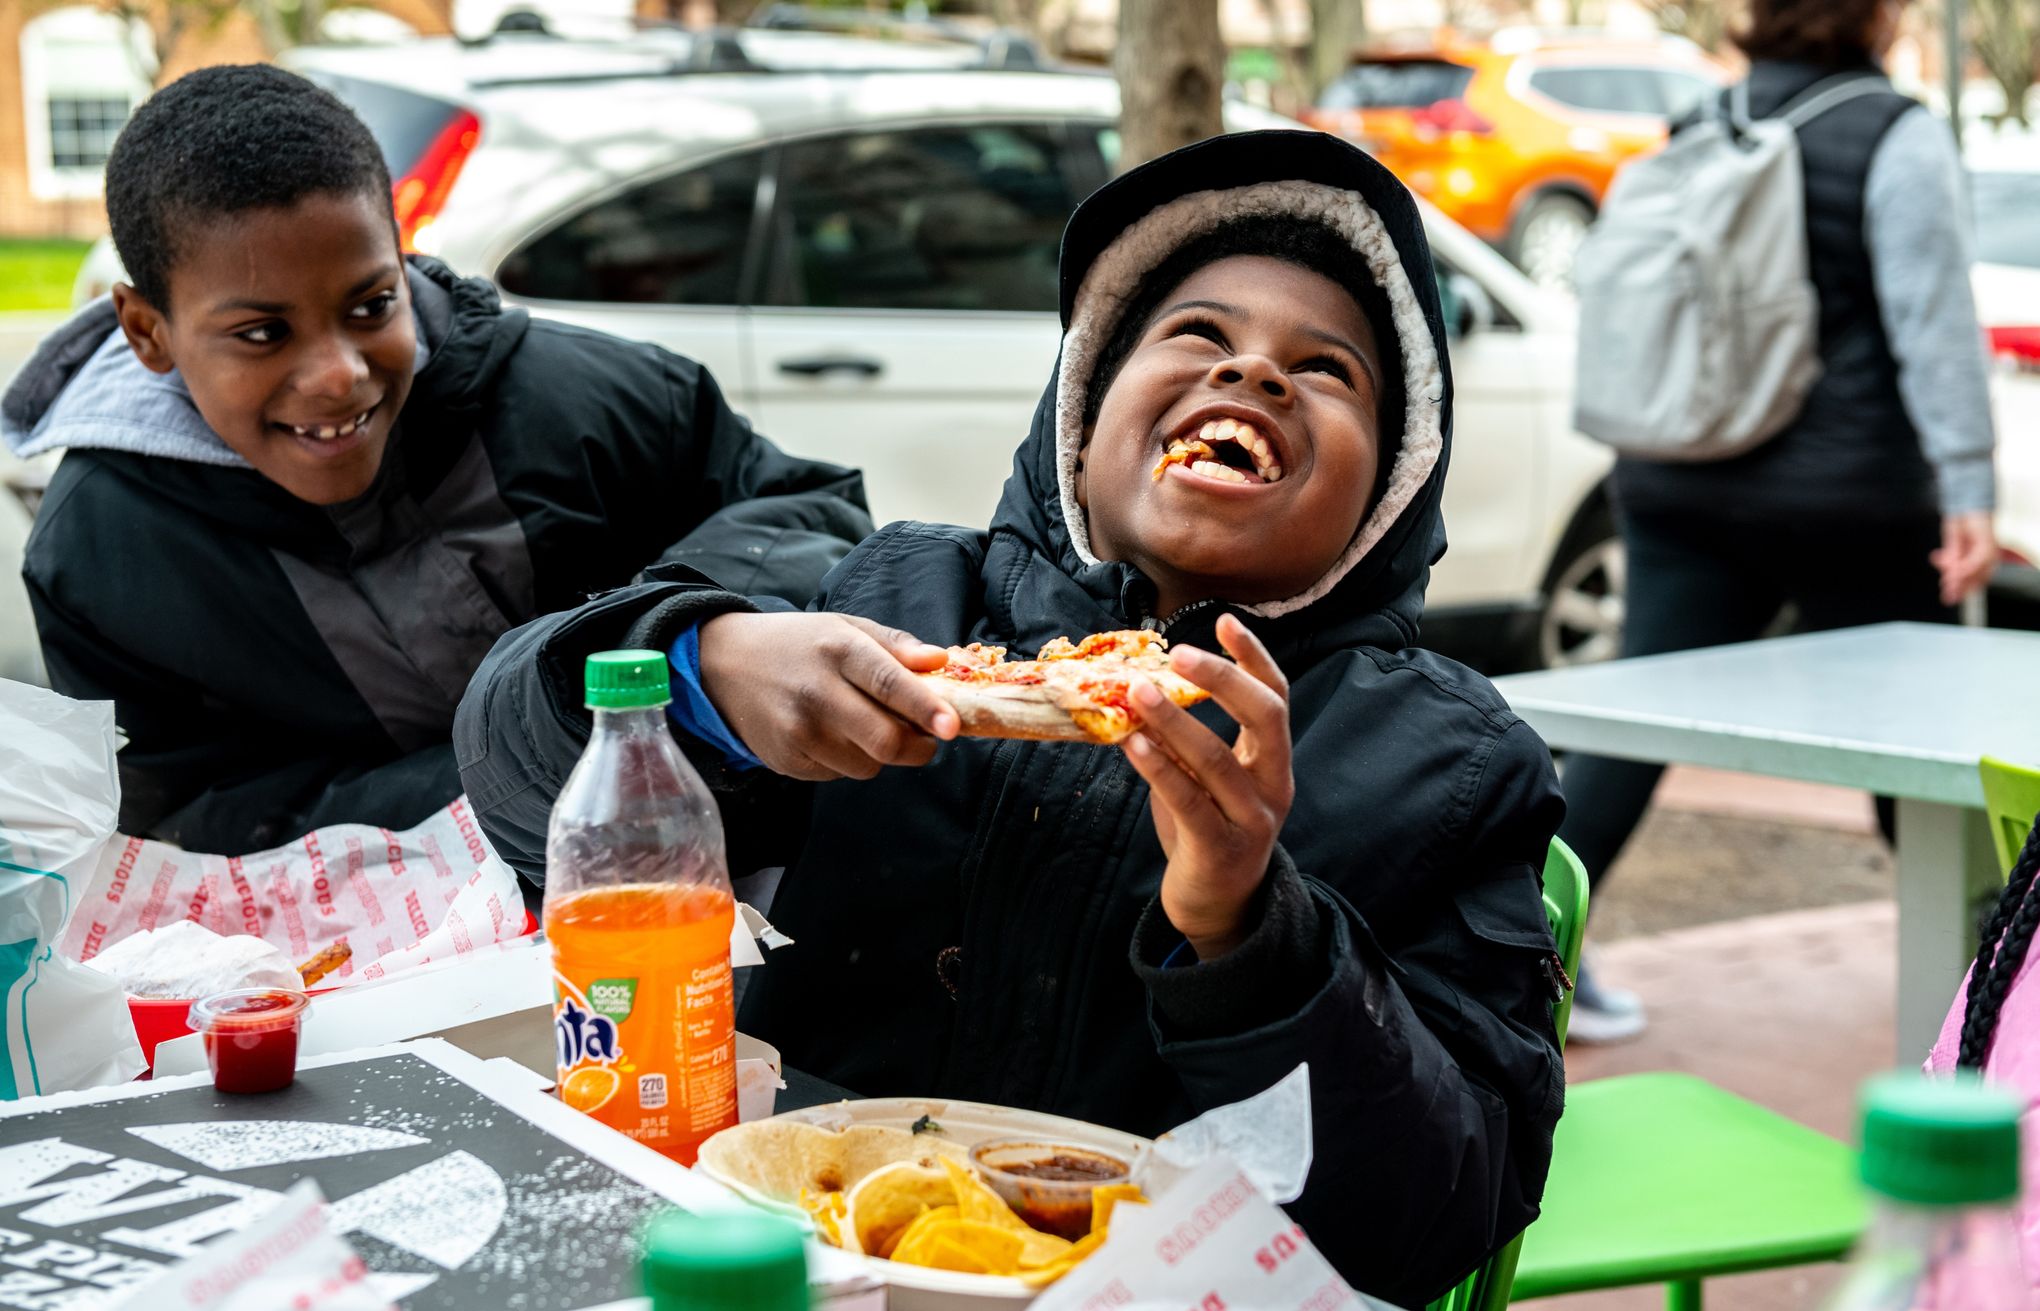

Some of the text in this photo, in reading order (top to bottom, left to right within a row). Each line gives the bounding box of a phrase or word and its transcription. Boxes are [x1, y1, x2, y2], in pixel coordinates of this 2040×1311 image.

[592, 985, 632, 1000] 100%
[686, 994, 714, 1009] Facts
[641, 1077, 664, 1091] 270
